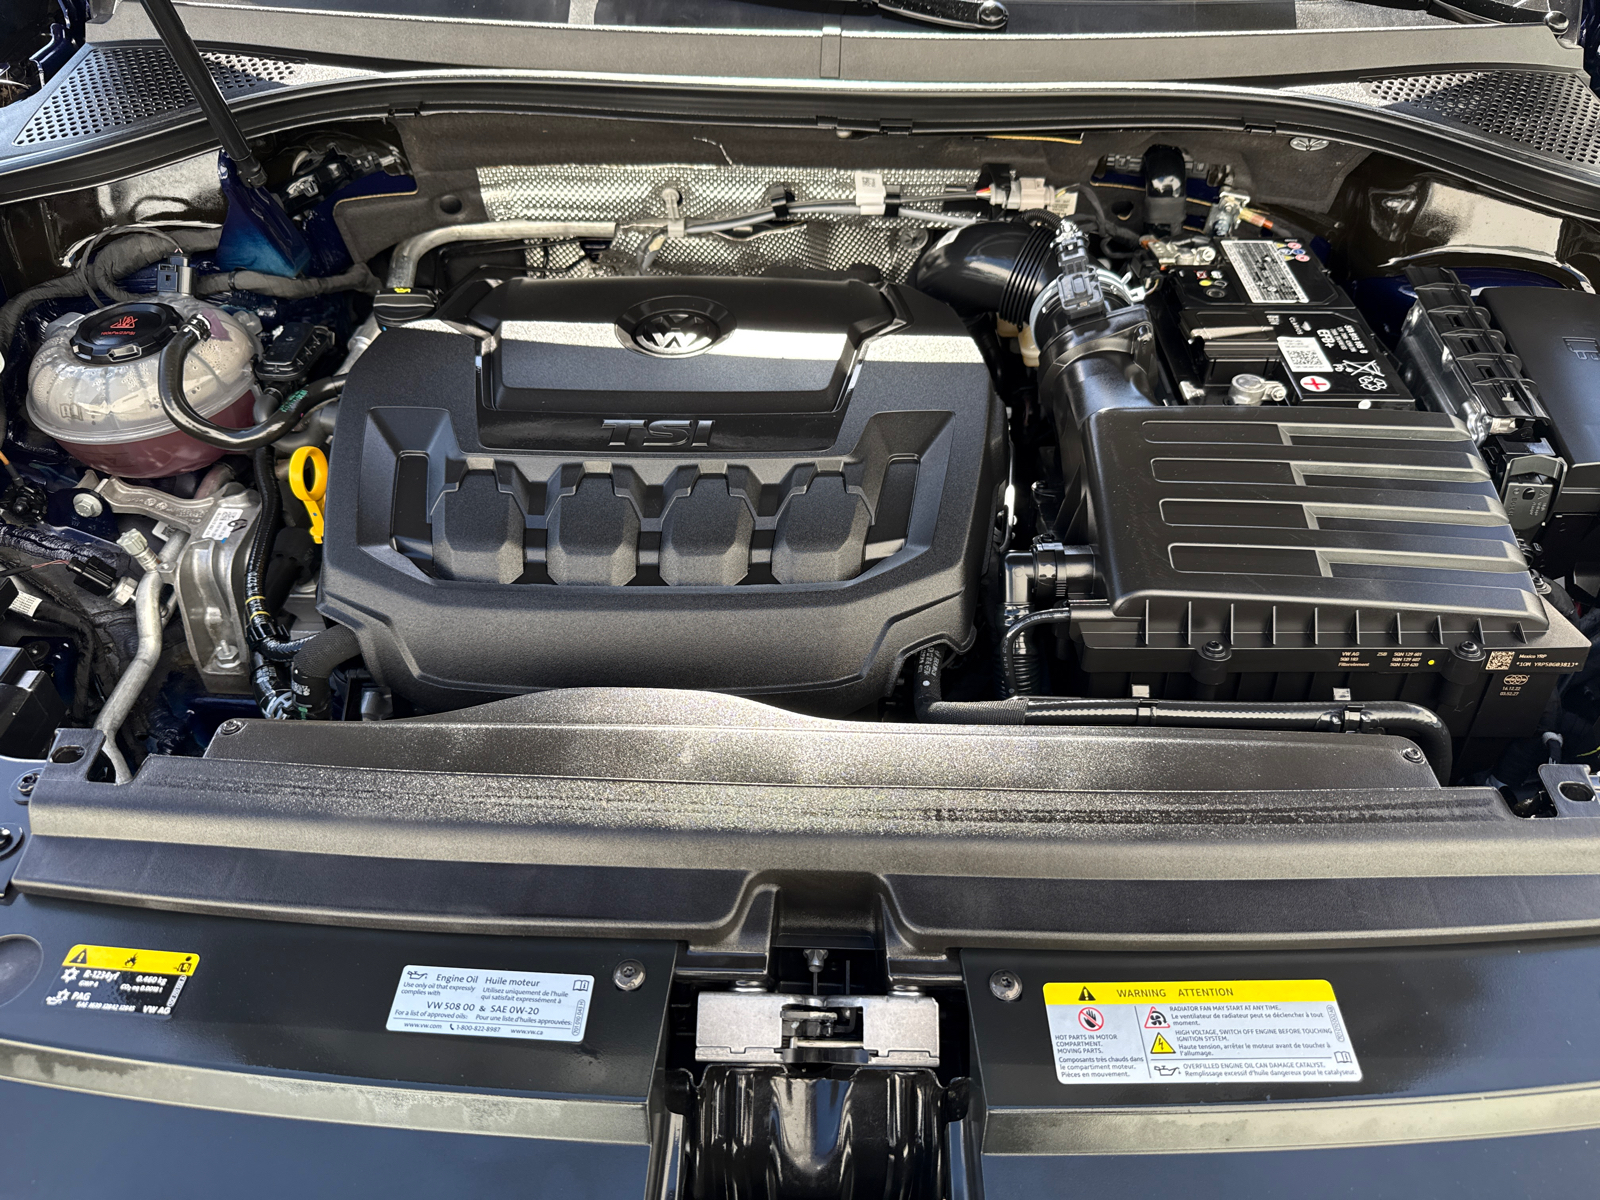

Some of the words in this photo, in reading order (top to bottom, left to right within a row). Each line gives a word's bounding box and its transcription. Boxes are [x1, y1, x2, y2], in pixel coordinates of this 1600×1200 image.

[602, 419, 715, 447] TSI
[83, 969, 120, 983] R-1234yf
[136, 975, 158, 984] 0.460
[158, 976, 167, 986] kg
[436, 974, 464, 983] Engine
[485, 977, 507, 985] Huile
[132, 985, 140, 993] eq
[1116, 989, 1166, 997] WARNING
[1178, 988, 1234, 997] ATTENTION
[71, 991, 91, 1001] PAG
[143, 1005, 158, 1014] VW
[157, 1006, 171, 1015] AG
[427, 1001, 443, 1009] VW
[444, 1002, 460, 1010] 508
[463, 1003, 475, 1011] 00
[490, 1005, 507, 1013] SAE
[509, 1006, 539, 1015] 0W-20
[456, 1024, 501, 1032] 1-800-822-8987
